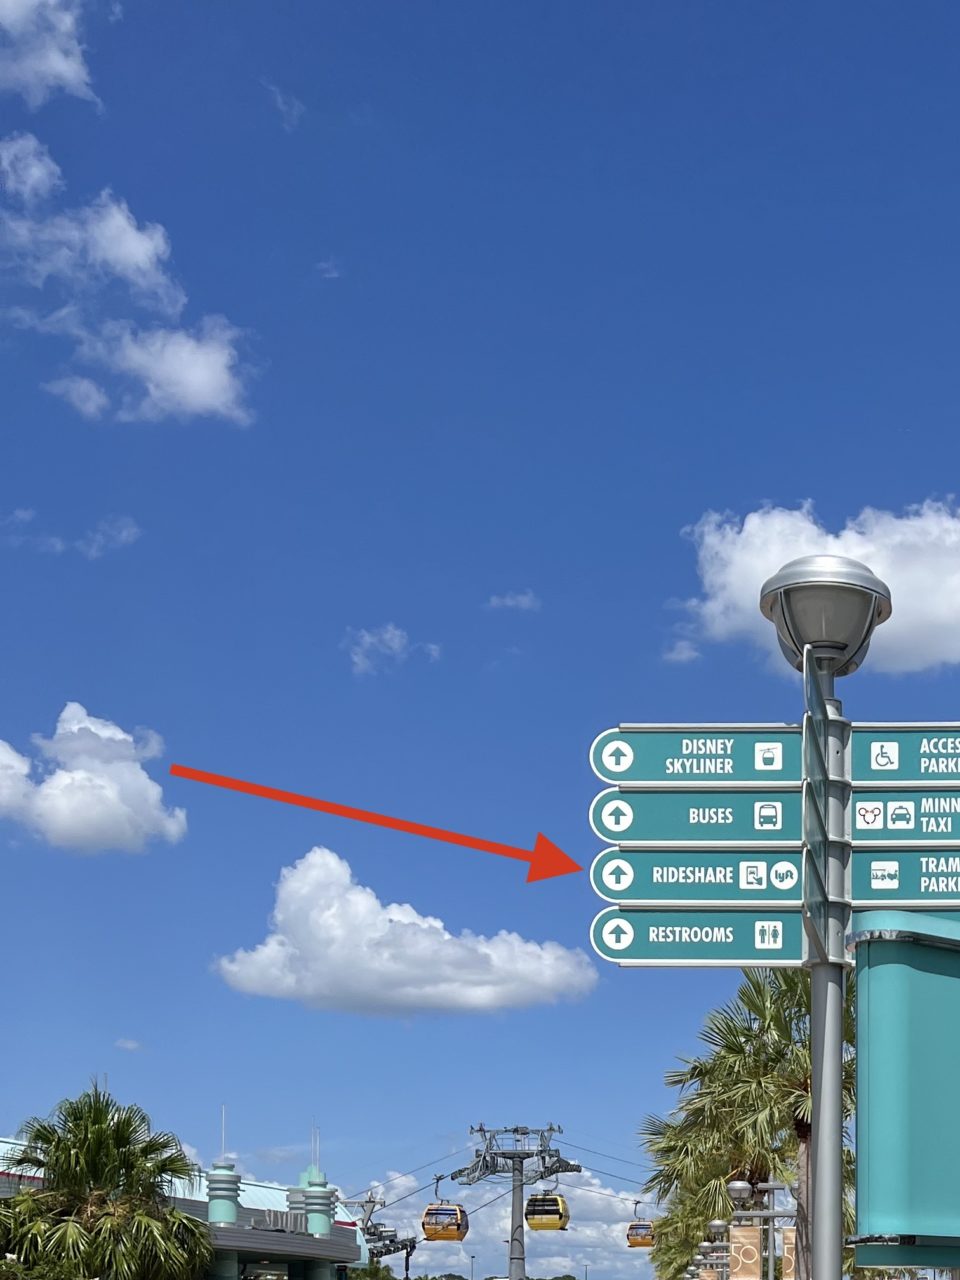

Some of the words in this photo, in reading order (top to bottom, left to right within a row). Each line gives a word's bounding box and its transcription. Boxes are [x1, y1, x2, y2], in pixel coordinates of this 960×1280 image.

[681, 738, 734, 755] DISNEY
[665, 758, 734, 774] SKYLINER
[689, 807, 733, 824] BUSES
[920, 816, 952, 833] TAXI
[652, 866, 734, 883] RIDESHARE
[774, 869, 794, 883] lyft
[648, 926, 734, 943] RESTROOMS
[730, 1243, 758, 1272] 50
[784, 1244, 796, 1273] 5
